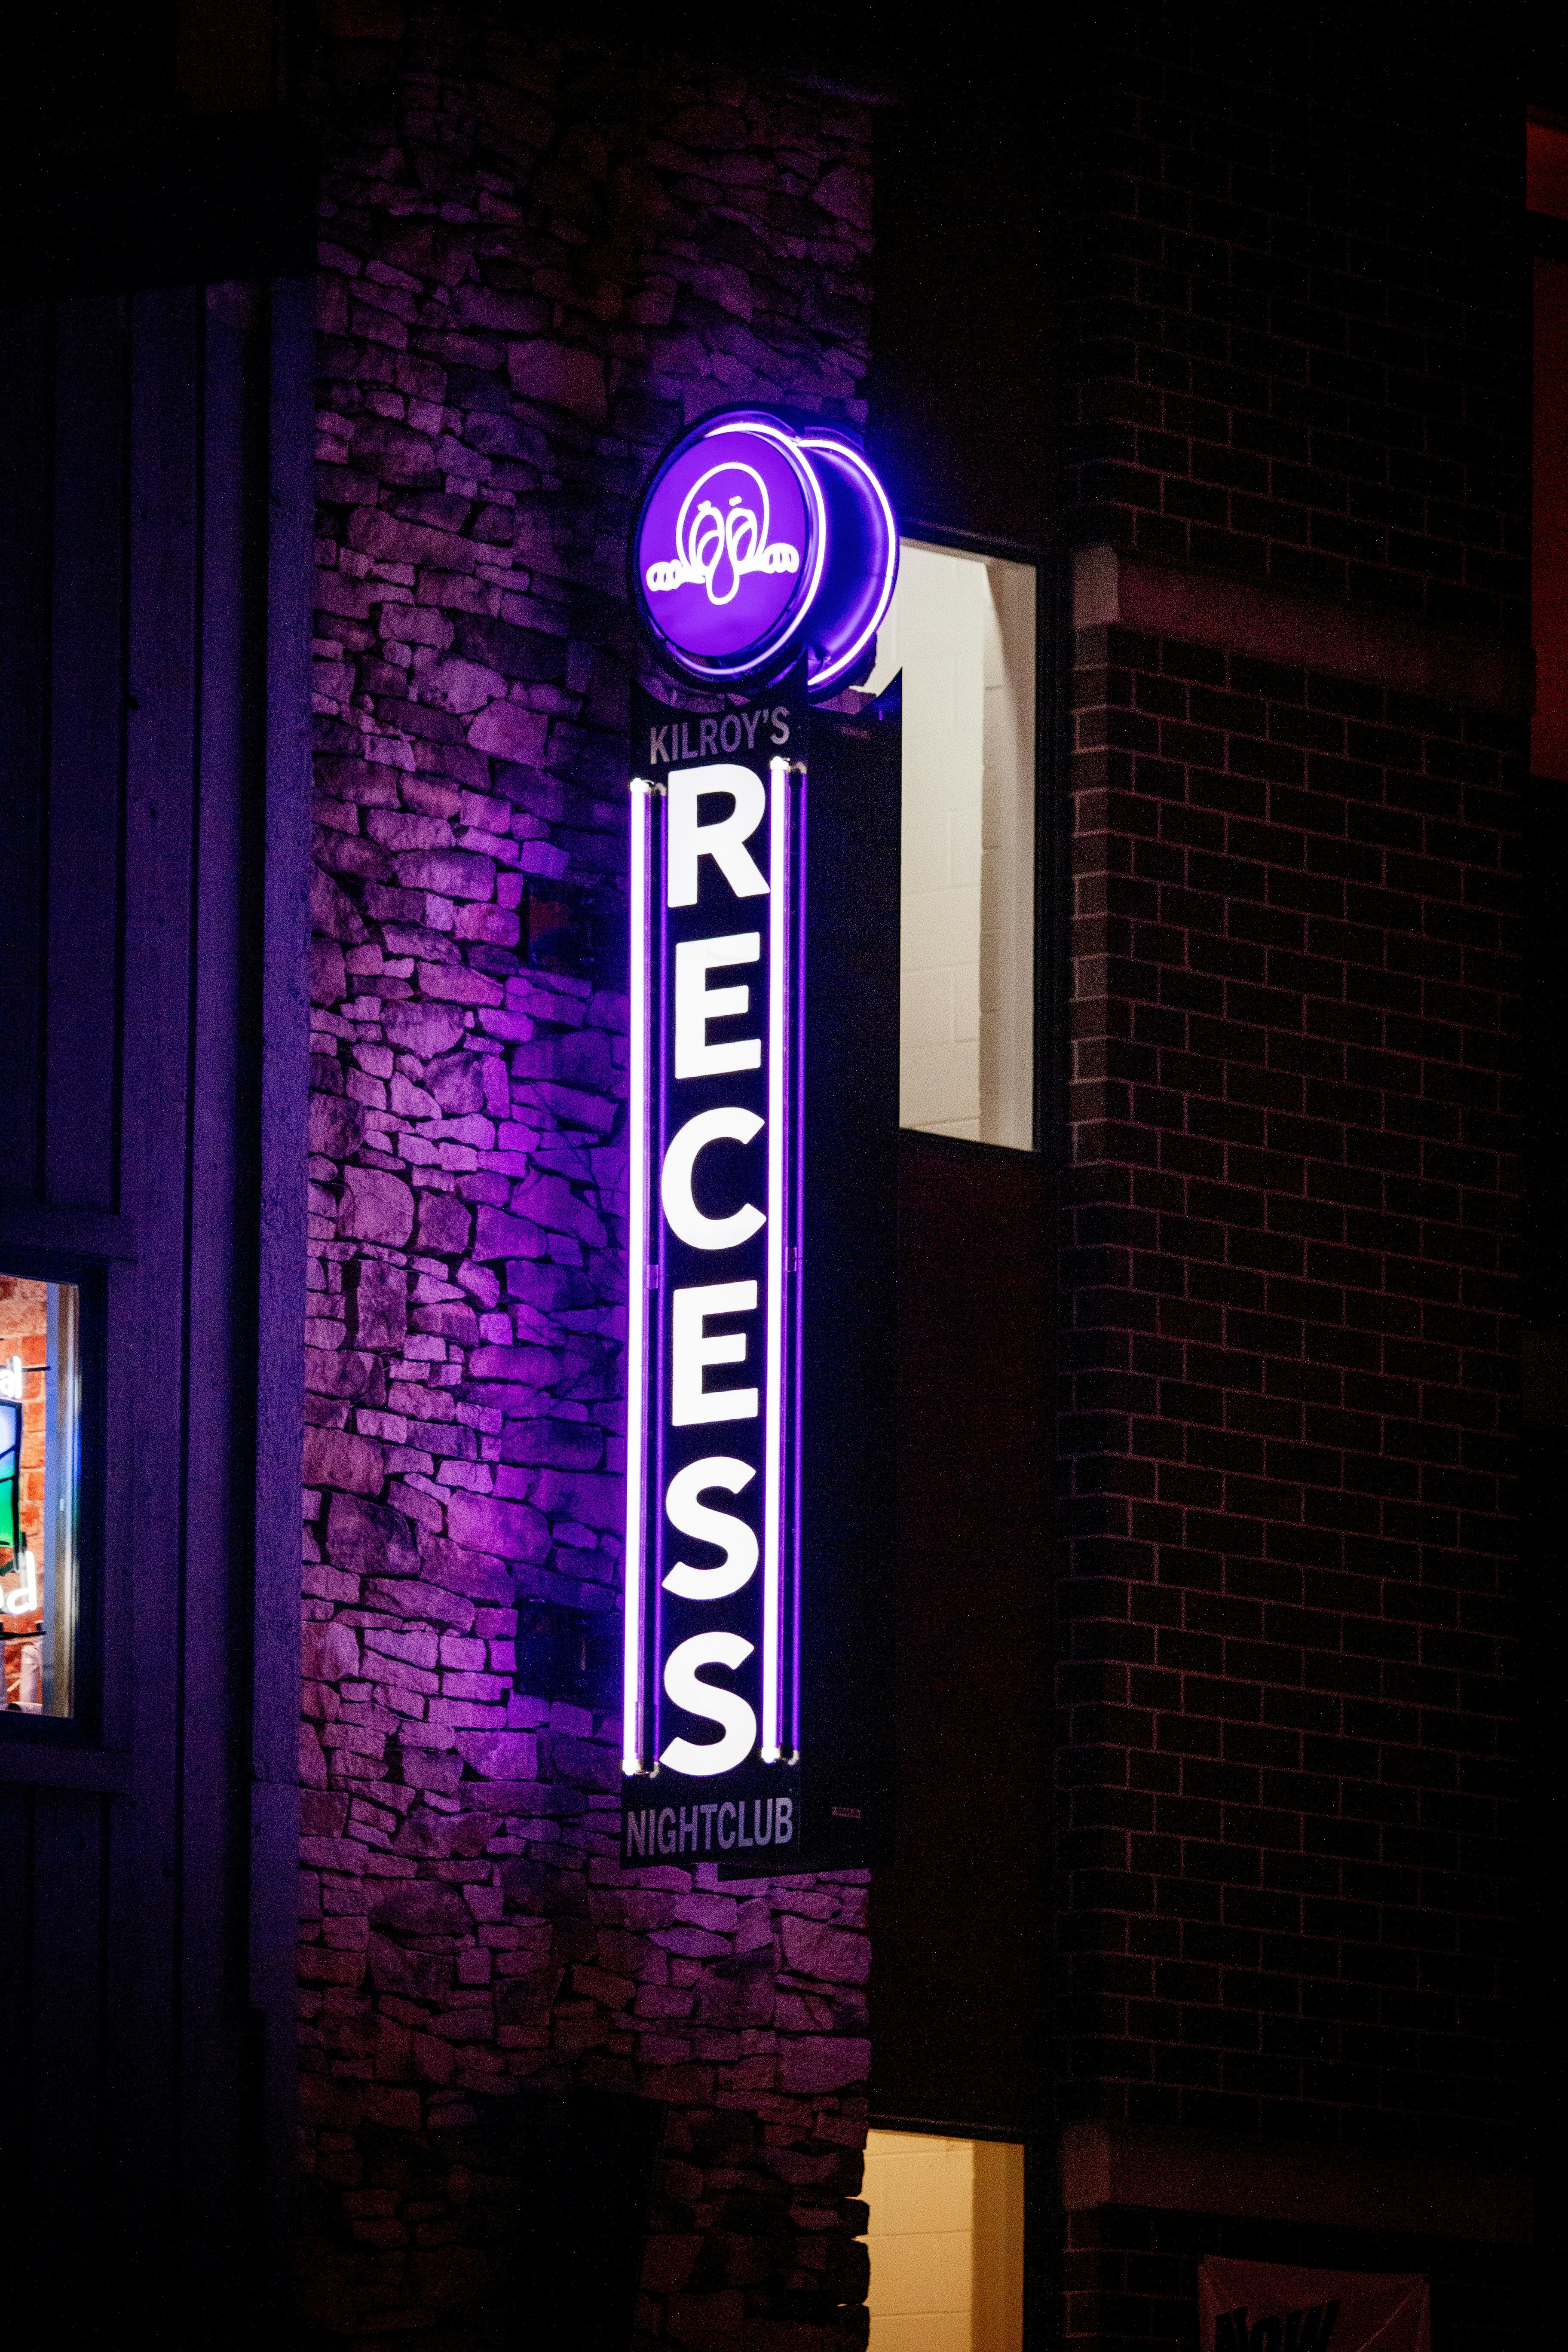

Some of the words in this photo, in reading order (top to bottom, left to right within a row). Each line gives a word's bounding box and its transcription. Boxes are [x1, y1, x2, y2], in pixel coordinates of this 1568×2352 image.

[649, 705, 790, 765] KILROY'S
[659, 763, 770, 1776] RECESS
[626, 1797, 793, 1857] NIGHTCLUB
